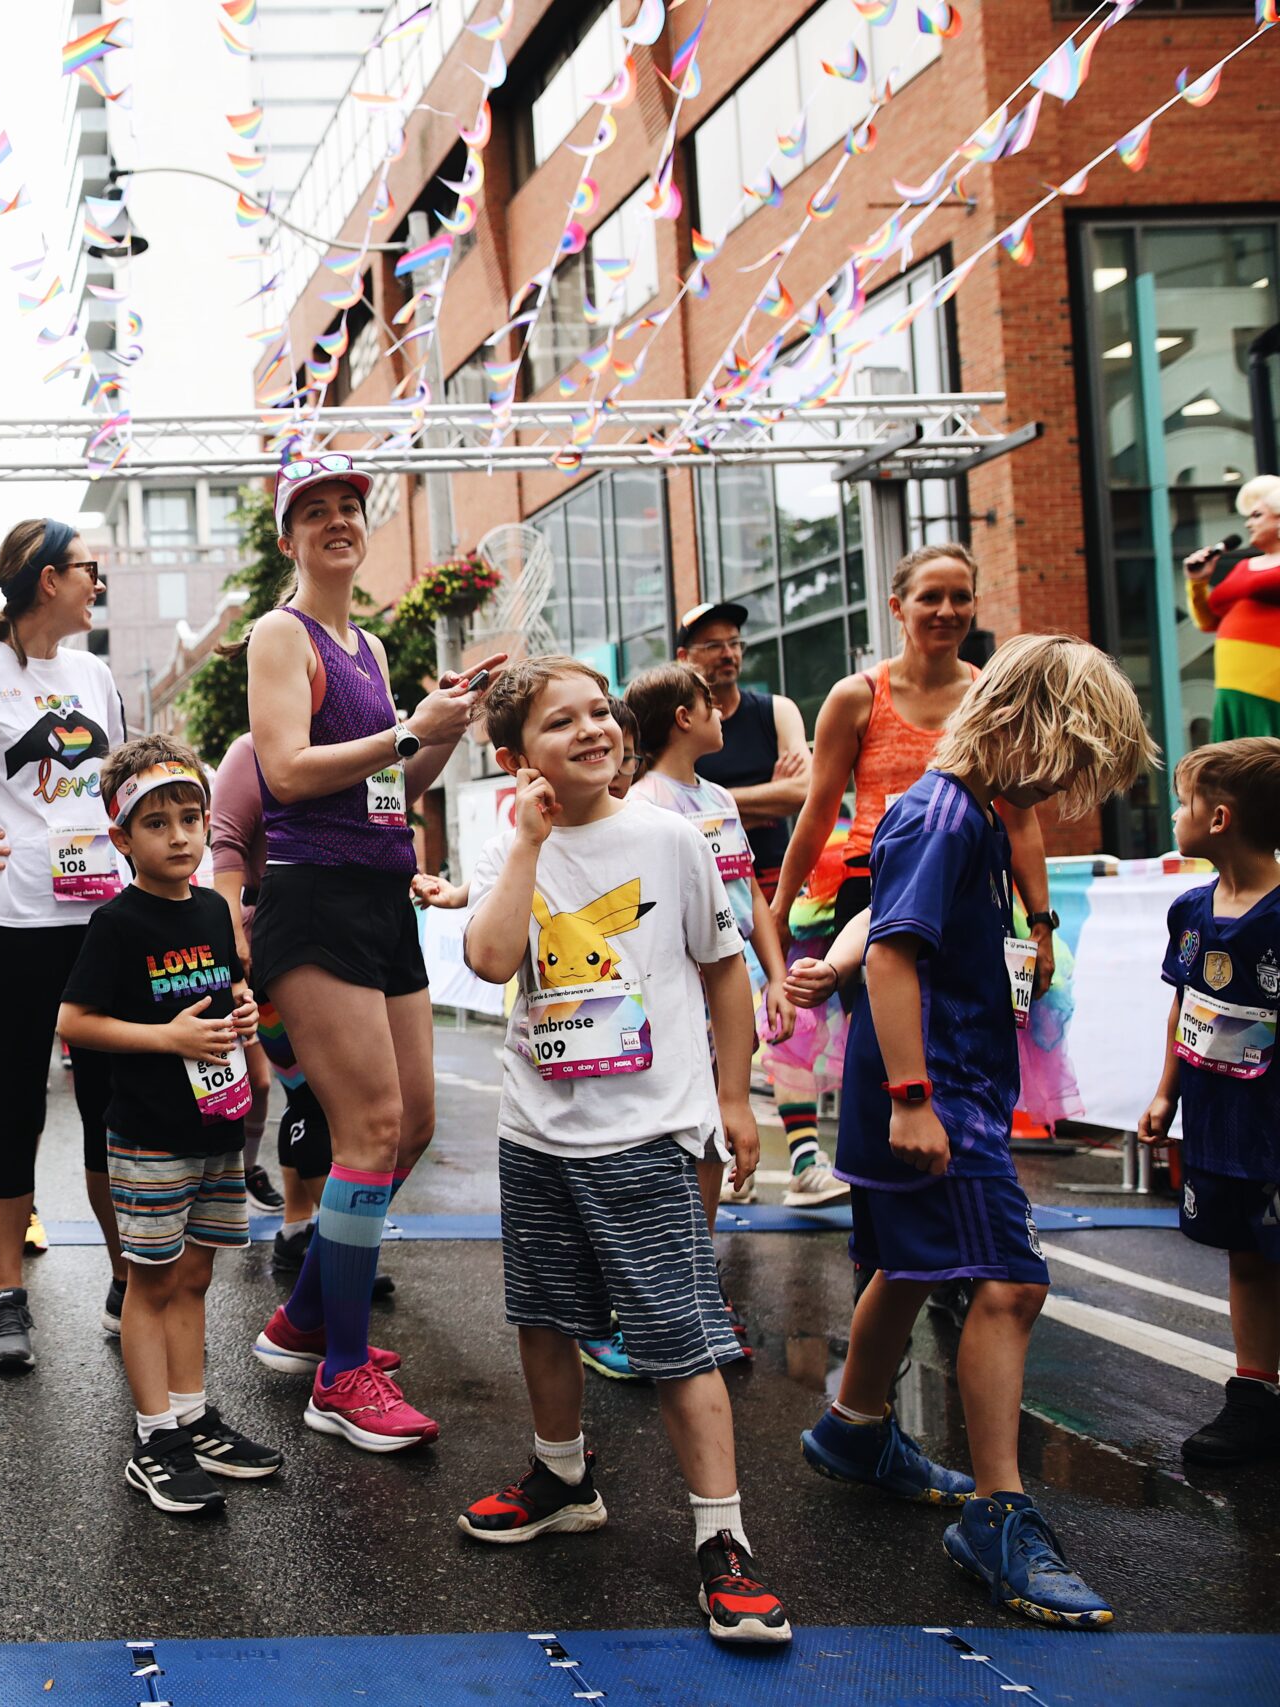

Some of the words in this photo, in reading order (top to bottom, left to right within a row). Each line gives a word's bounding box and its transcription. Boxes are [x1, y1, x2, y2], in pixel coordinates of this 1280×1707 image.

[34, 694, 83, 710] LOVE
[33, 756, 102, 804] love
[375, 796, 401, 810] 2206
[58, 843, 83, 859] gabe
[60, 860, 87, 874] 108
[146, 944, 215, 978] LOVE
[548, 989, 583, 998] remembrance
[1015, 988, 1029, 1008] 116
[533, 1016, 594, 1035] ambrose
[1184, 1012, 1214, 1035] morgan
[624, 1037, 639, 1046] kids
[1183, 1027, 1198, 1047] 115
[535, 1040, 566, 1061] 109
[1245, 1052, 1260, 1060] kids
[614, 1060, 632, 1068] HOKA
[1230, 1066, 1247, 1075] HOKA
[202, 1067, 235, 1092] 108
[226, 1105, 237, 1115] bag
